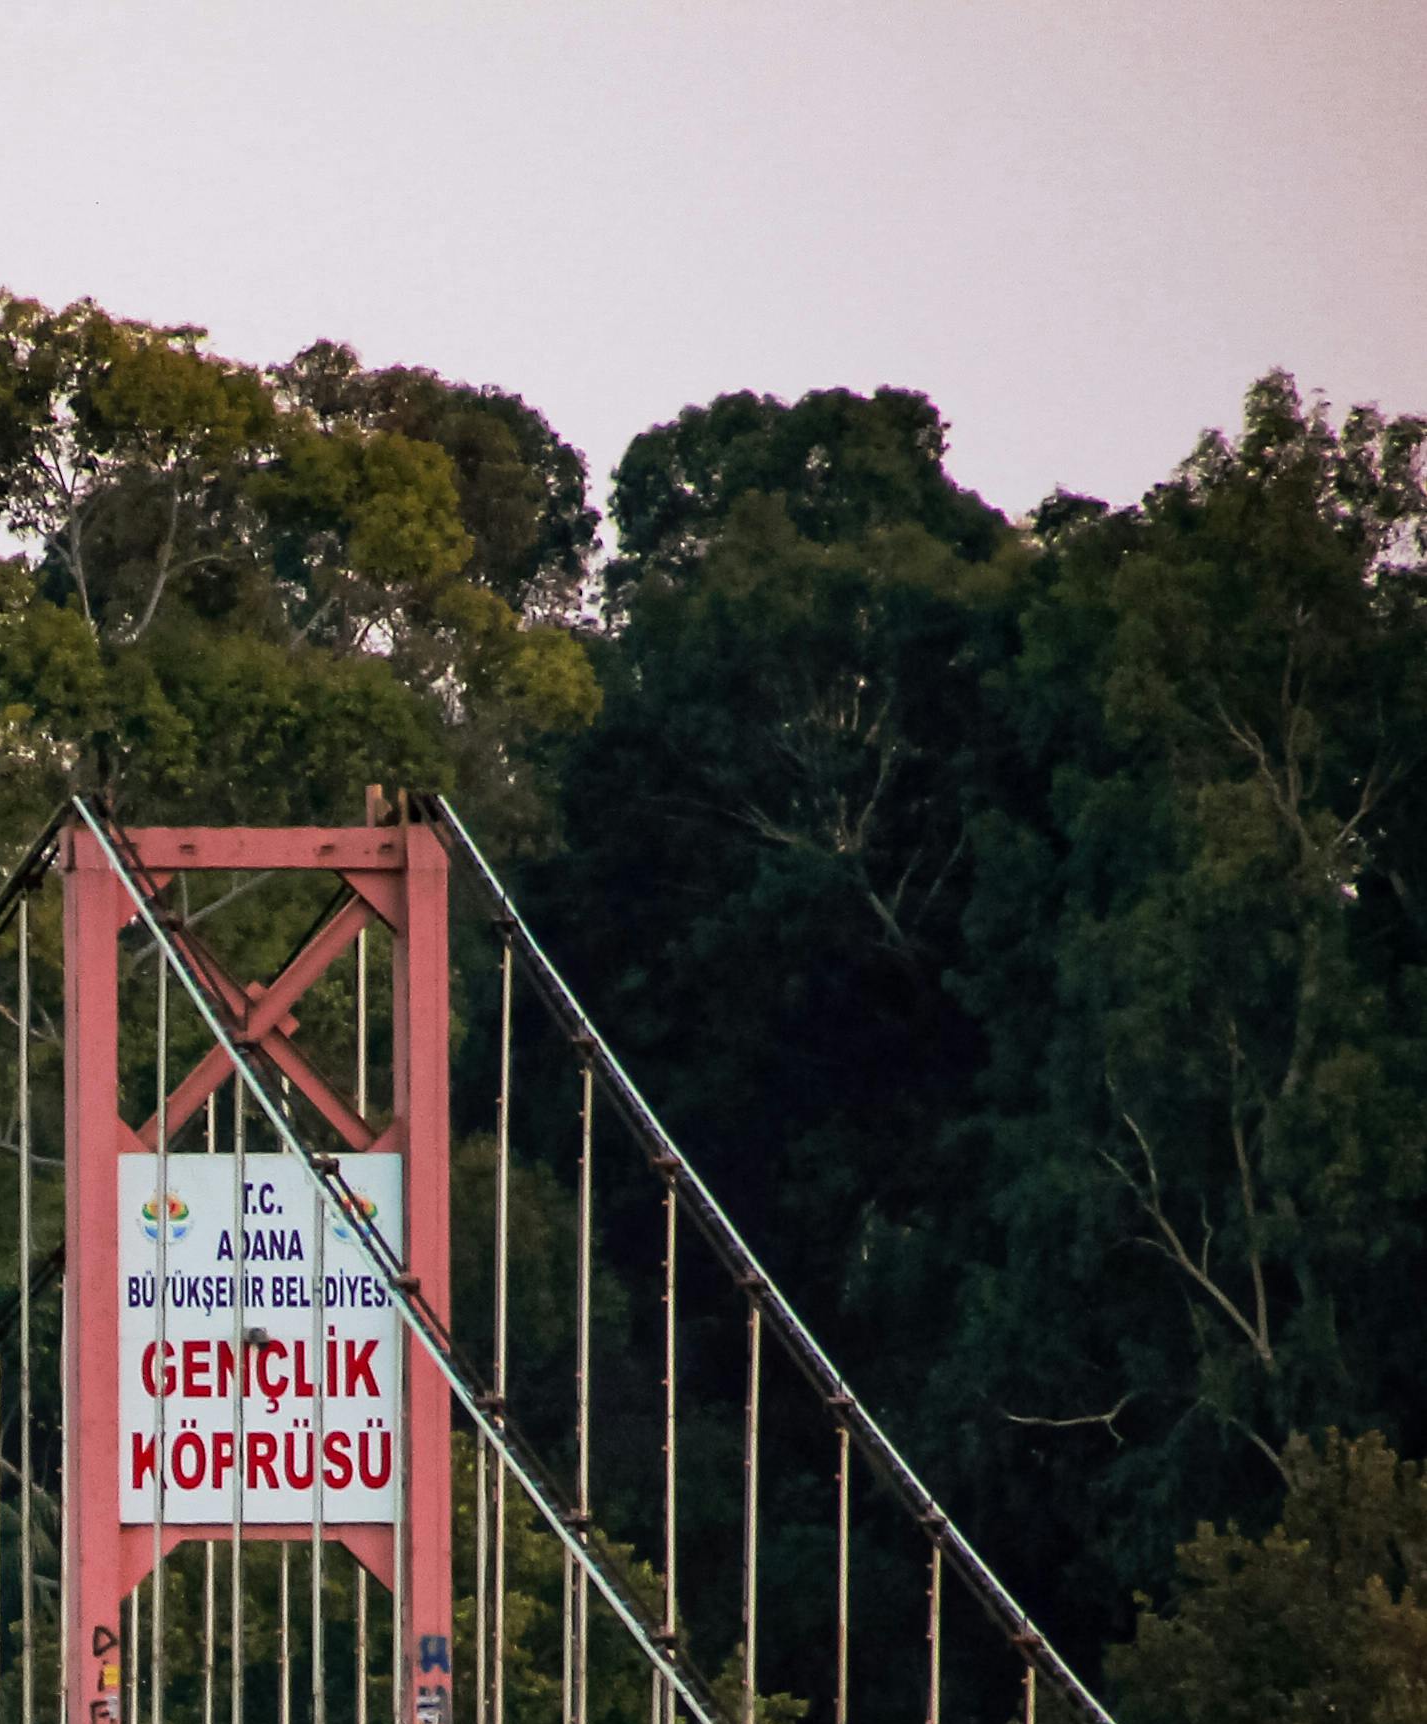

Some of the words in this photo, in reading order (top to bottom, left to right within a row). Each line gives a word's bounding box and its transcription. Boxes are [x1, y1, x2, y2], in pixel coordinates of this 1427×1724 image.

[241, 1182, 283, 1214] T.C.
[128, 1268, 264, 1316] BÜÜKŞEİR
[272, 1268, 394, 1309] BELDİYES
[141, 1325, 381, 1413] GENÇLİK
[132, 1418, 392, 1490] KÖPRÜSÜ
